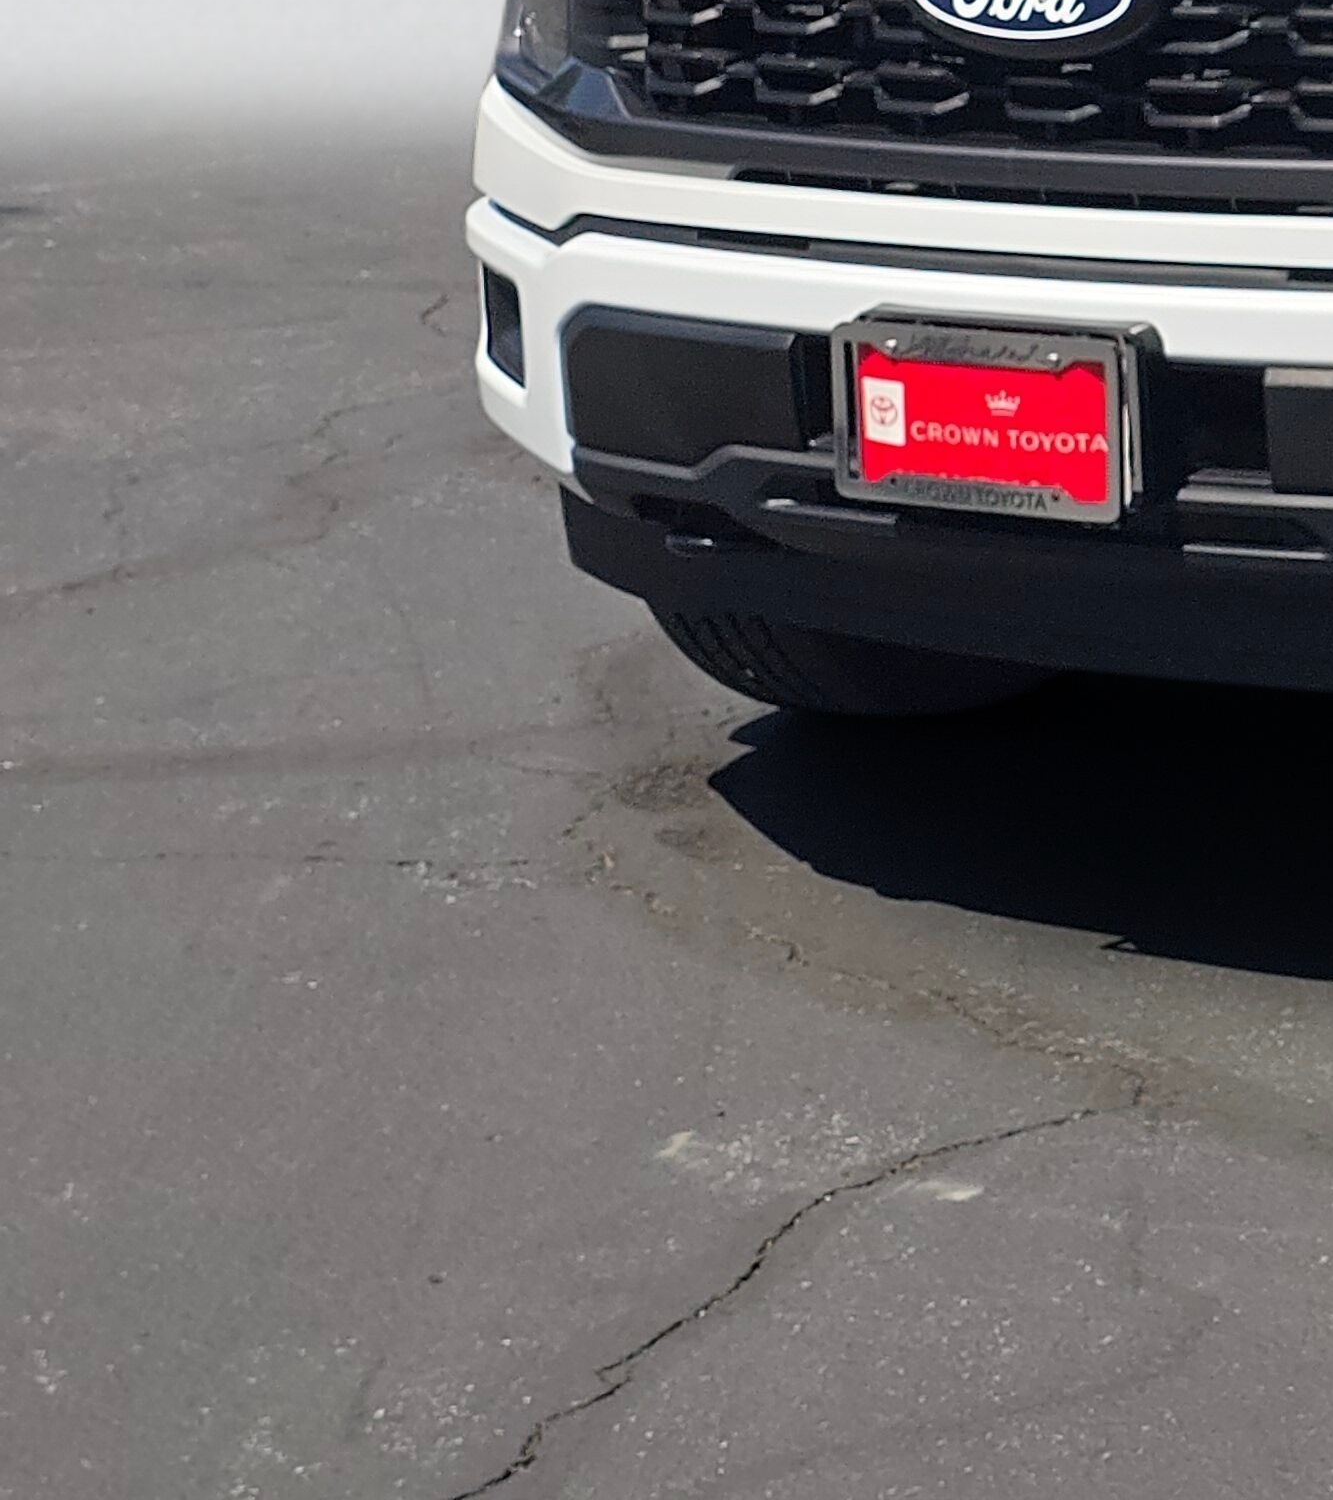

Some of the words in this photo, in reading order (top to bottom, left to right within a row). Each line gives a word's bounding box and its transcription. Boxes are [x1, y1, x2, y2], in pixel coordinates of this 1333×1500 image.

[910, 420, 1000, 448] CROWN
[1007, 428, 1110, 454] TOYOTA
[973, 484, 1048, 512] TOYOTA
